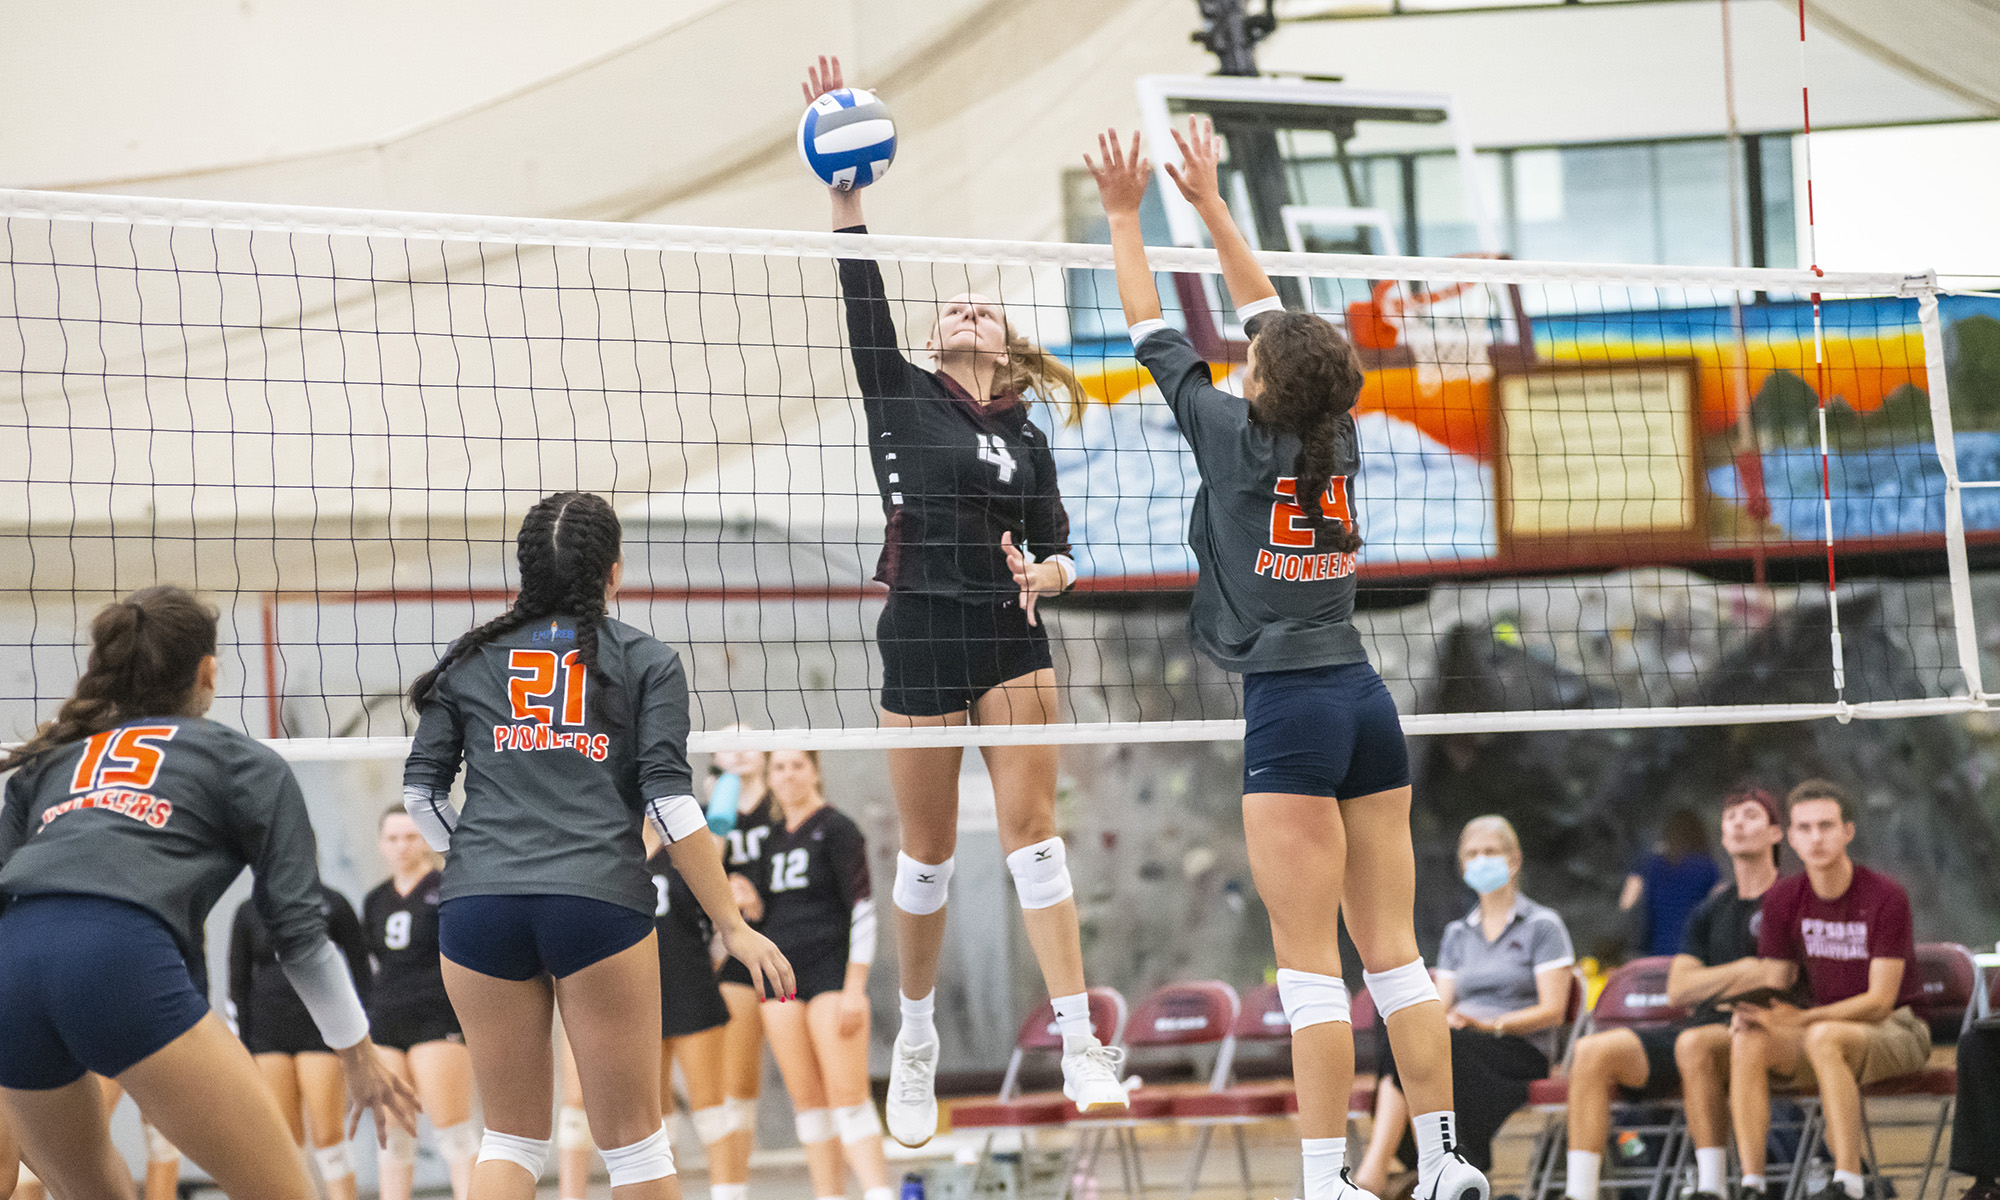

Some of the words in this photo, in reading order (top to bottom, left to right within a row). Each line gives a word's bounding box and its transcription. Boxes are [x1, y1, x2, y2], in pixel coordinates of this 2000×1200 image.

[976, 433, 1017, 484] 4
[1269, 475, 1354, 548] 24
[1254, 547, 1357, 582] PIONEERS
[508, 649, 587, 726] 21
[69, 725, 179, 794] 15
[769, 847, 809, 893] 12
[384, 909, 412, 951] 9
